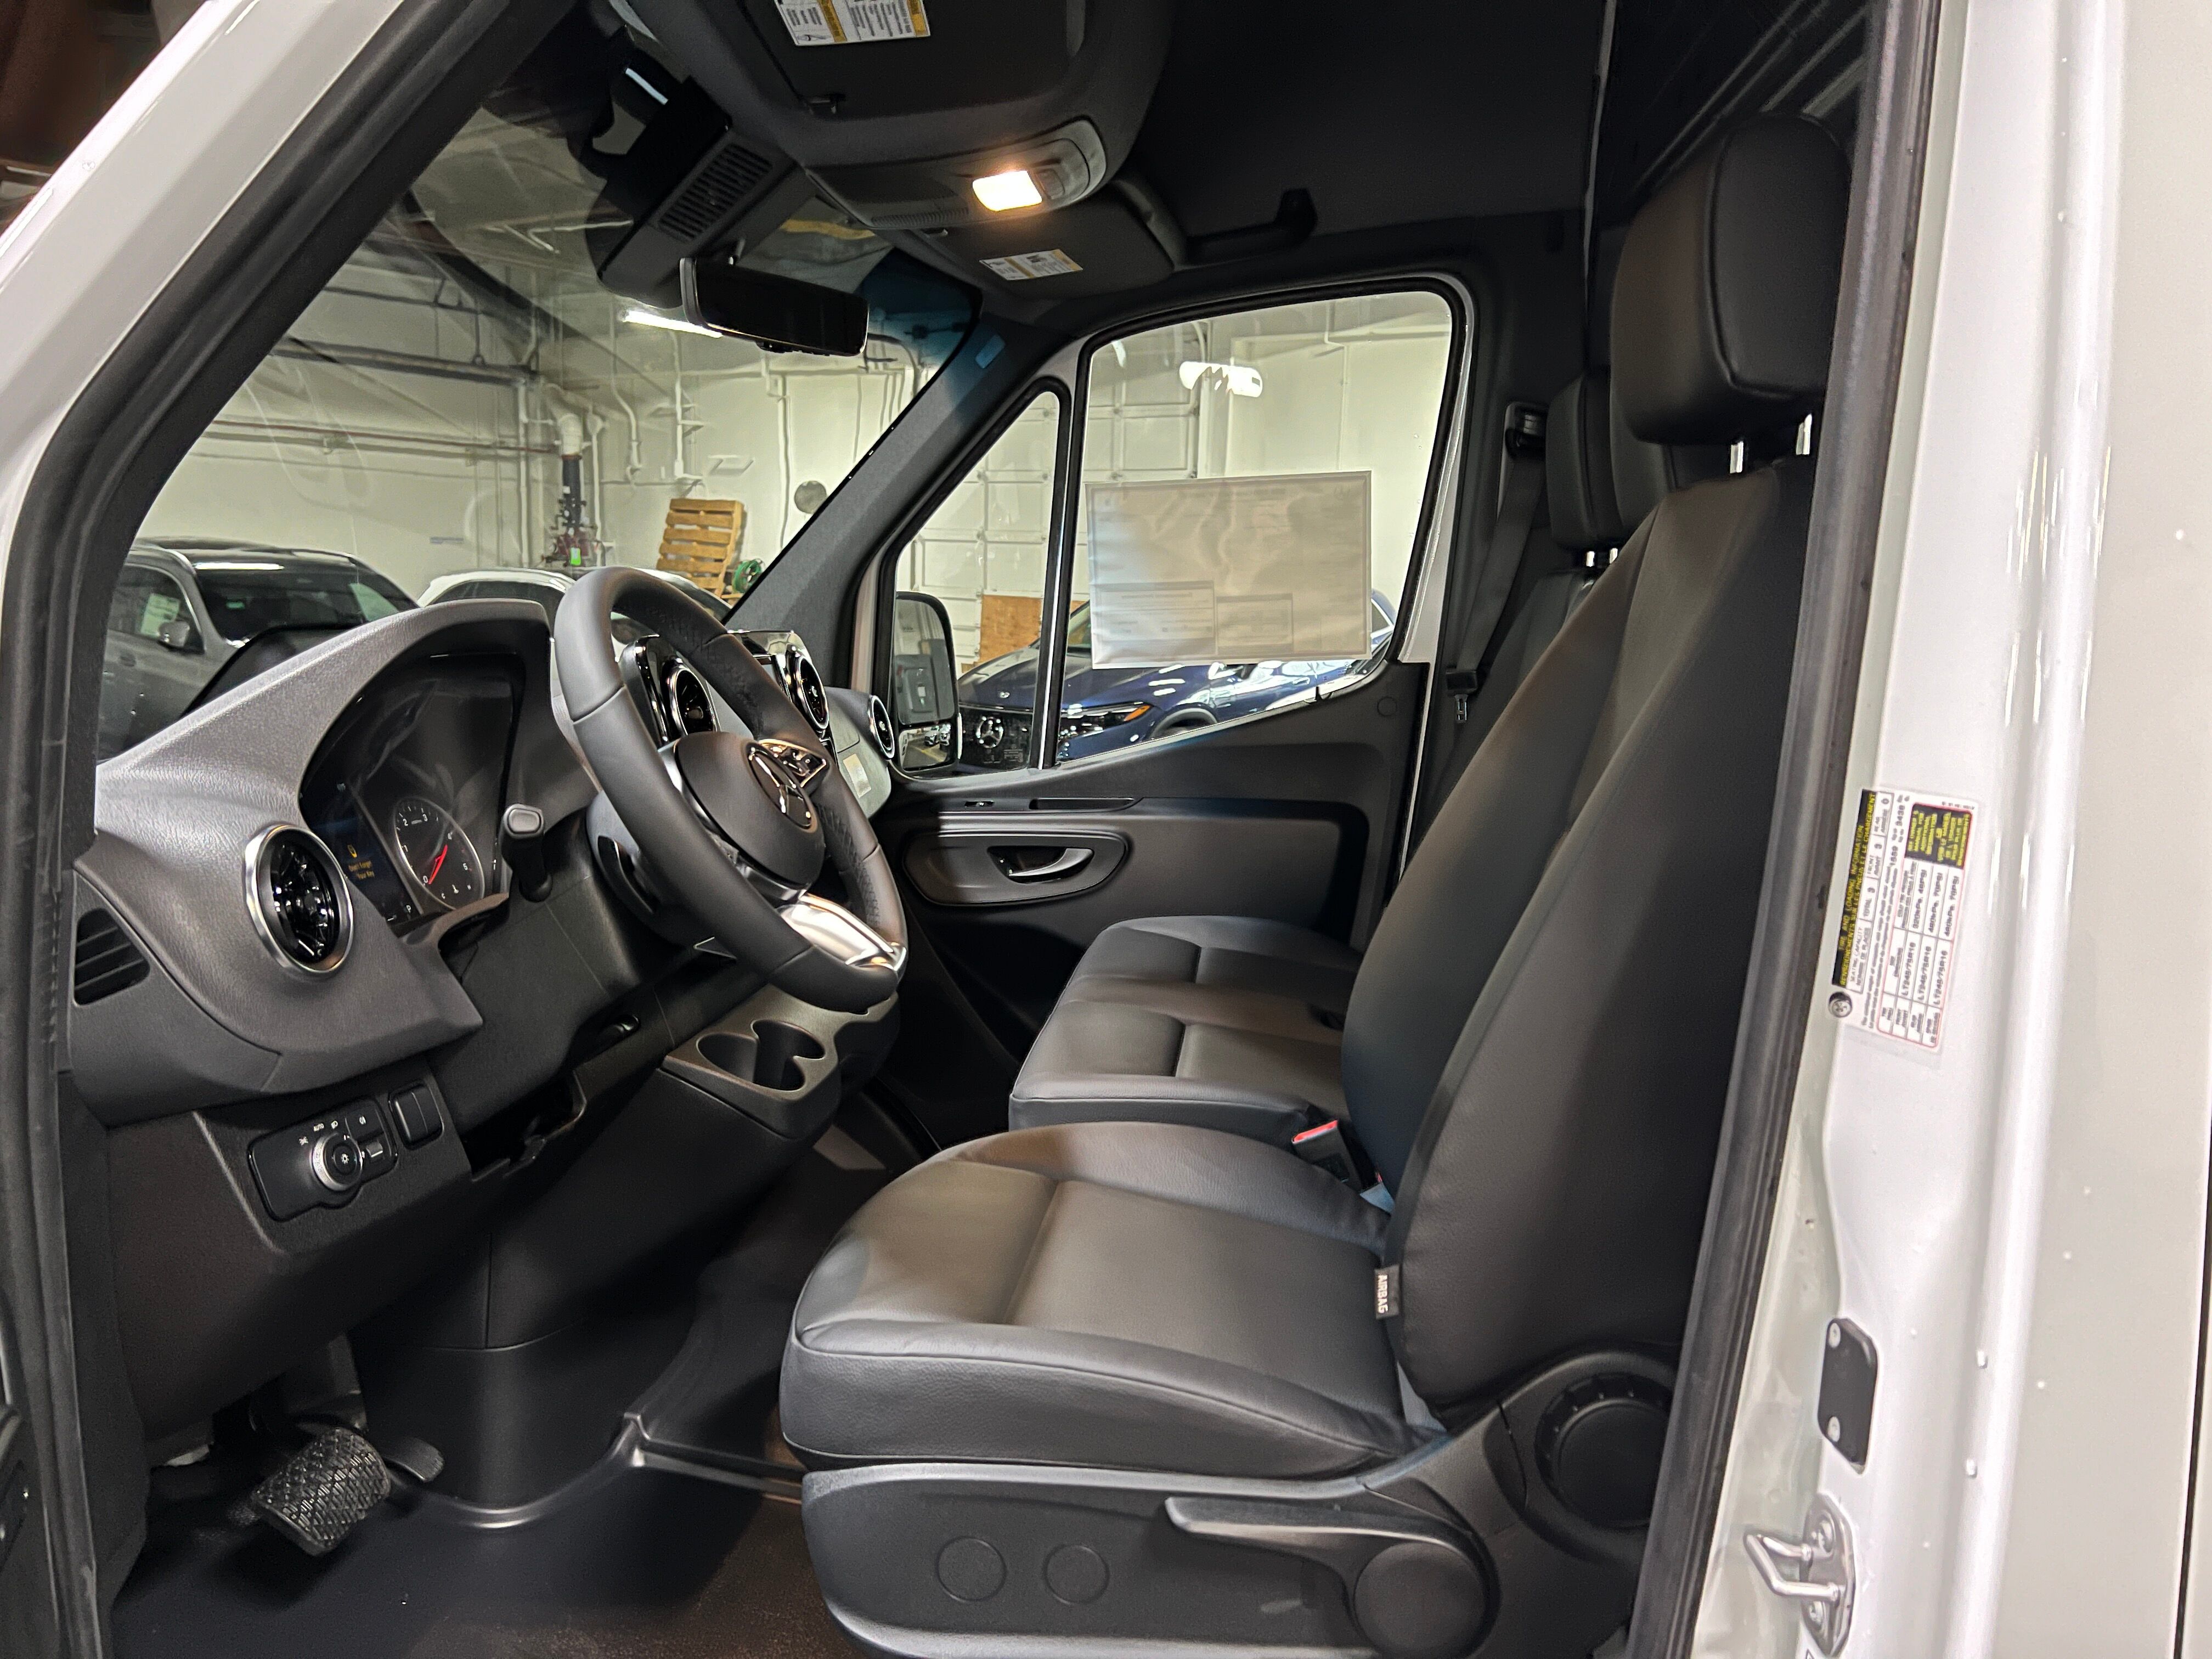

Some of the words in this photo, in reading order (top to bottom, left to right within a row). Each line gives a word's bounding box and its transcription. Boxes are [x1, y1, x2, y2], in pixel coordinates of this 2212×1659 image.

[422, 814, 428, 822] 3
[1841, 915, 1849, 930] AND
[1377, 1273, 1389, 1314] AIRBAG
